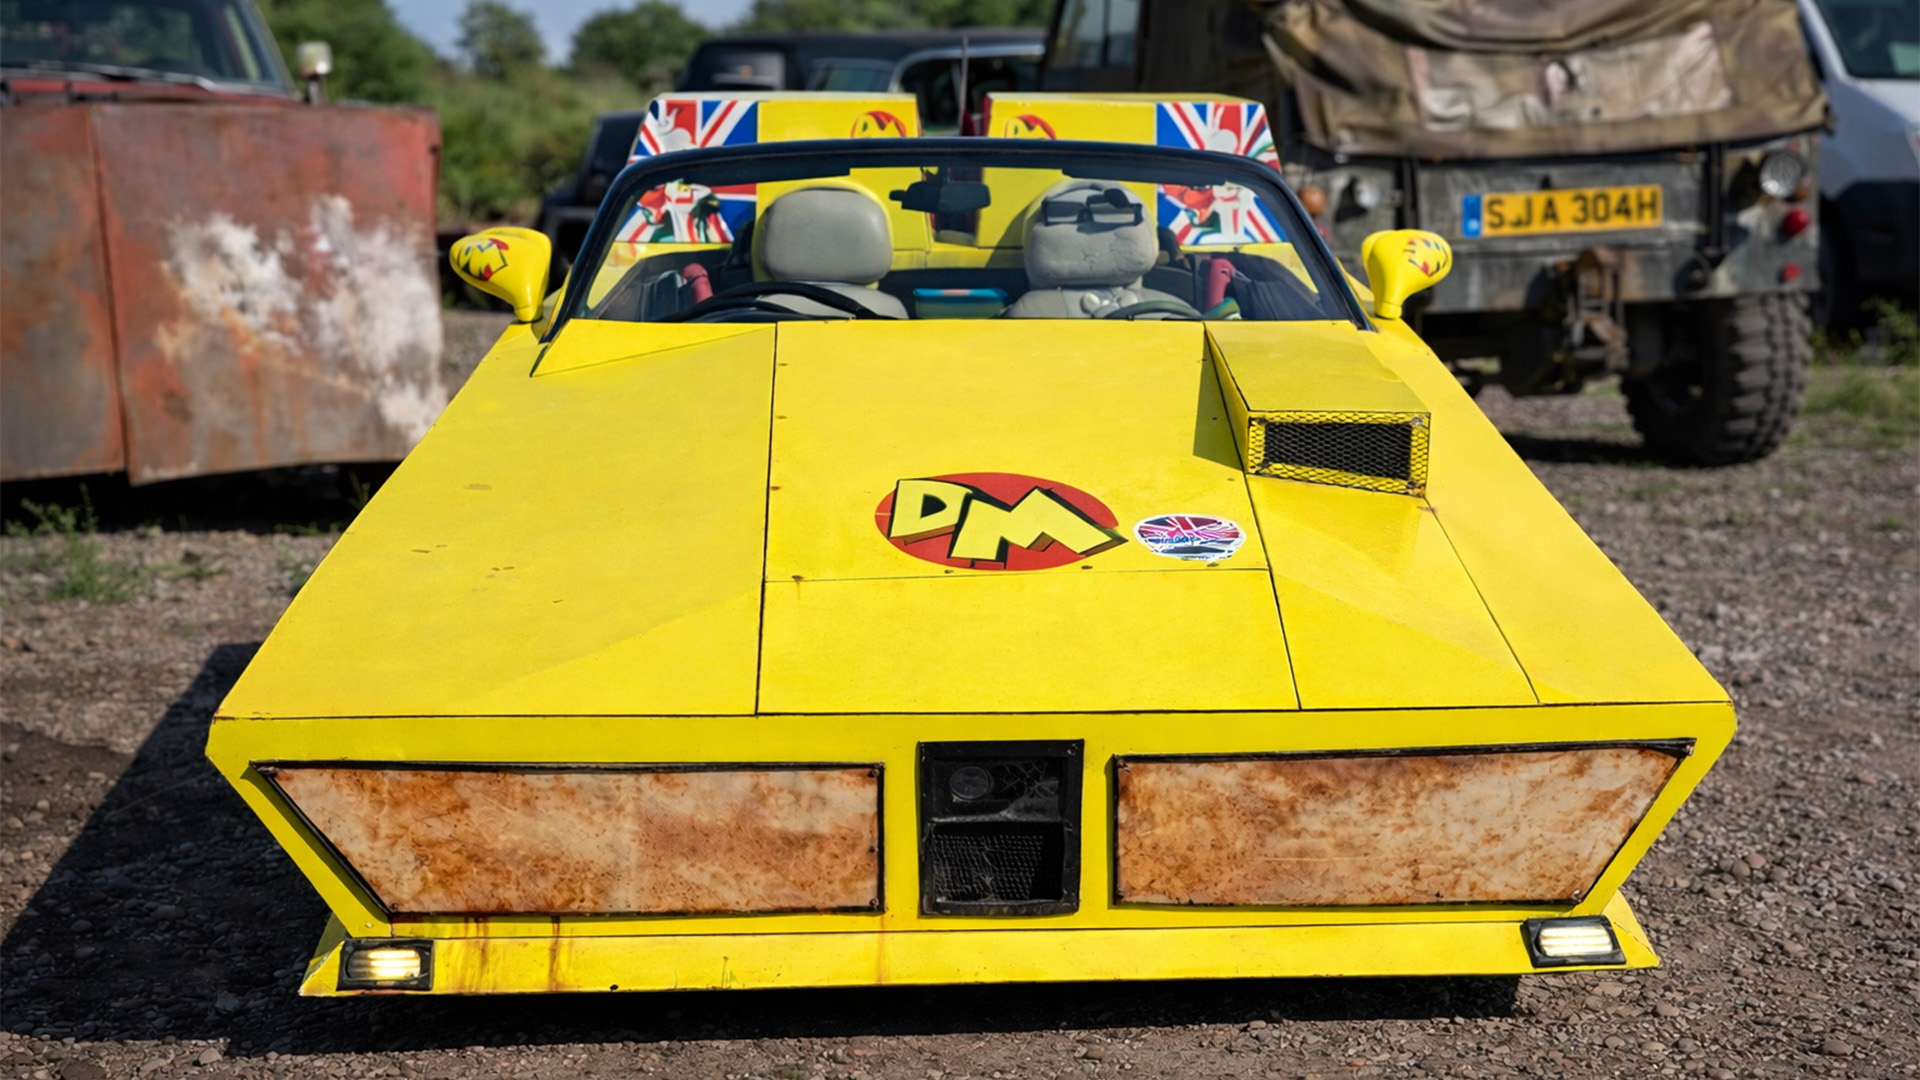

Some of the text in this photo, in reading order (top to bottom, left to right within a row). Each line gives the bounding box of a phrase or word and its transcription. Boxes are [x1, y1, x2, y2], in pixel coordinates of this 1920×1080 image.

[1486, 190, 1659, 229] SJA 304H
[888, 479, 1122, 562] DM
